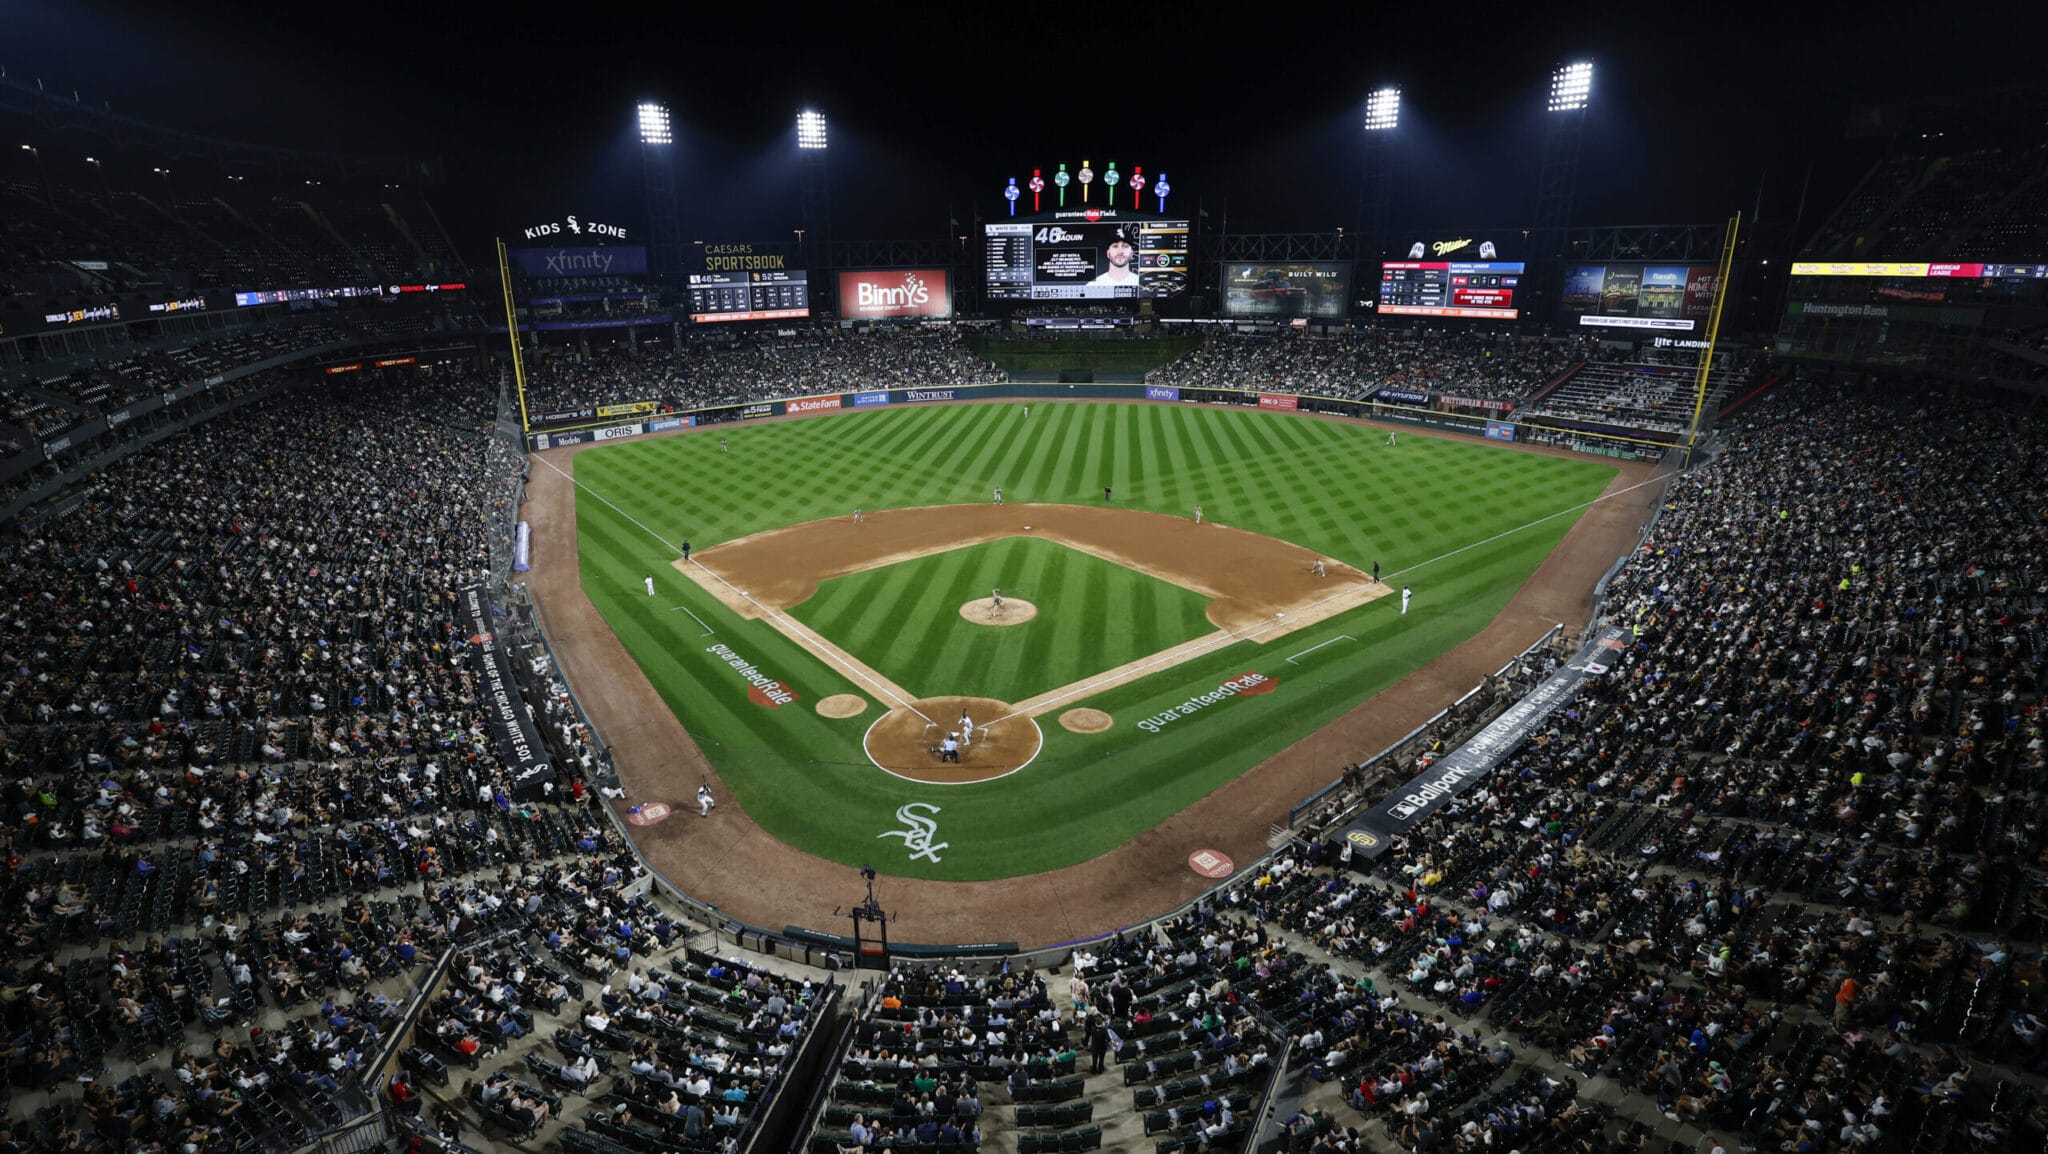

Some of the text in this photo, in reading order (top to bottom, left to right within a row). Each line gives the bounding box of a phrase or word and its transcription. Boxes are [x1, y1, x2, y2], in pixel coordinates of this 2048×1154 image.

[525, 222, 561, 239] KIDS
[588, 222, 627, 239] ZONE
[705, 245, 753, 254] CAESARS
[1433, 239, 1472, 256] Miller
[545, 250, 613, 274] xfinity
[706, 255, 784, 271] SPORTSBOOK
[762, 273, 773, 281] 52
[1803, 303, 1888, 317] Huntington Bank
[1655, 337, 1672, 348] Lite
[907, 391, 954, 400] WINTRUST
[1150, 388, 1173, 399] xfinity
[1391, 392, 1424, 400] HYUNDAI
[605, 426, 633, 438] ORIS
[706, 643, 792, 705] guaranteed Rate
[482, 653, 533, 762] HOME OF THE CHICAGO WHITE SOX
[1137, 672, 1269, 733] guaranteed Rate
[1466, 677, 1568, 755] DOWNLOAD AND CHECK-IN
[1404, 766, 1473, 807] Ballpark
[1028, 1035, 1034, 1043] 7
